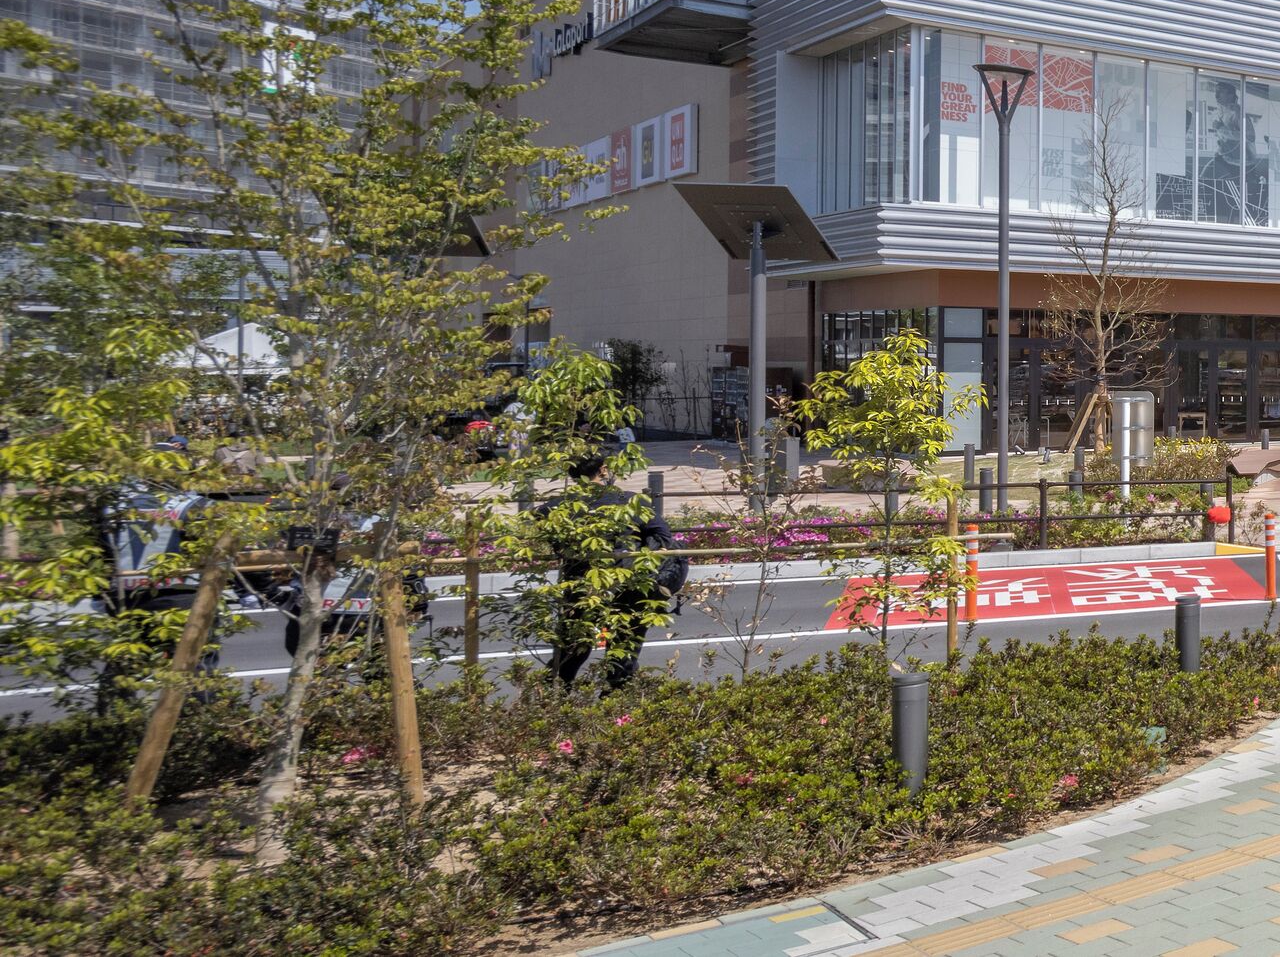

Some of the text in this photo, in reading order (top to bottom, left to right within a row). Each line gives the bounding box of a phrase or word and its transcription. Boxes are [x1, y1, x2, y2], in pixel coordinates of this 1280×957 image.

[941, 81, 967, 93] FIND
[942, 91, 973, 104] YOUR
[941, 102, 977, 114] GREAT
[941, 111, 968, 122] NESS
